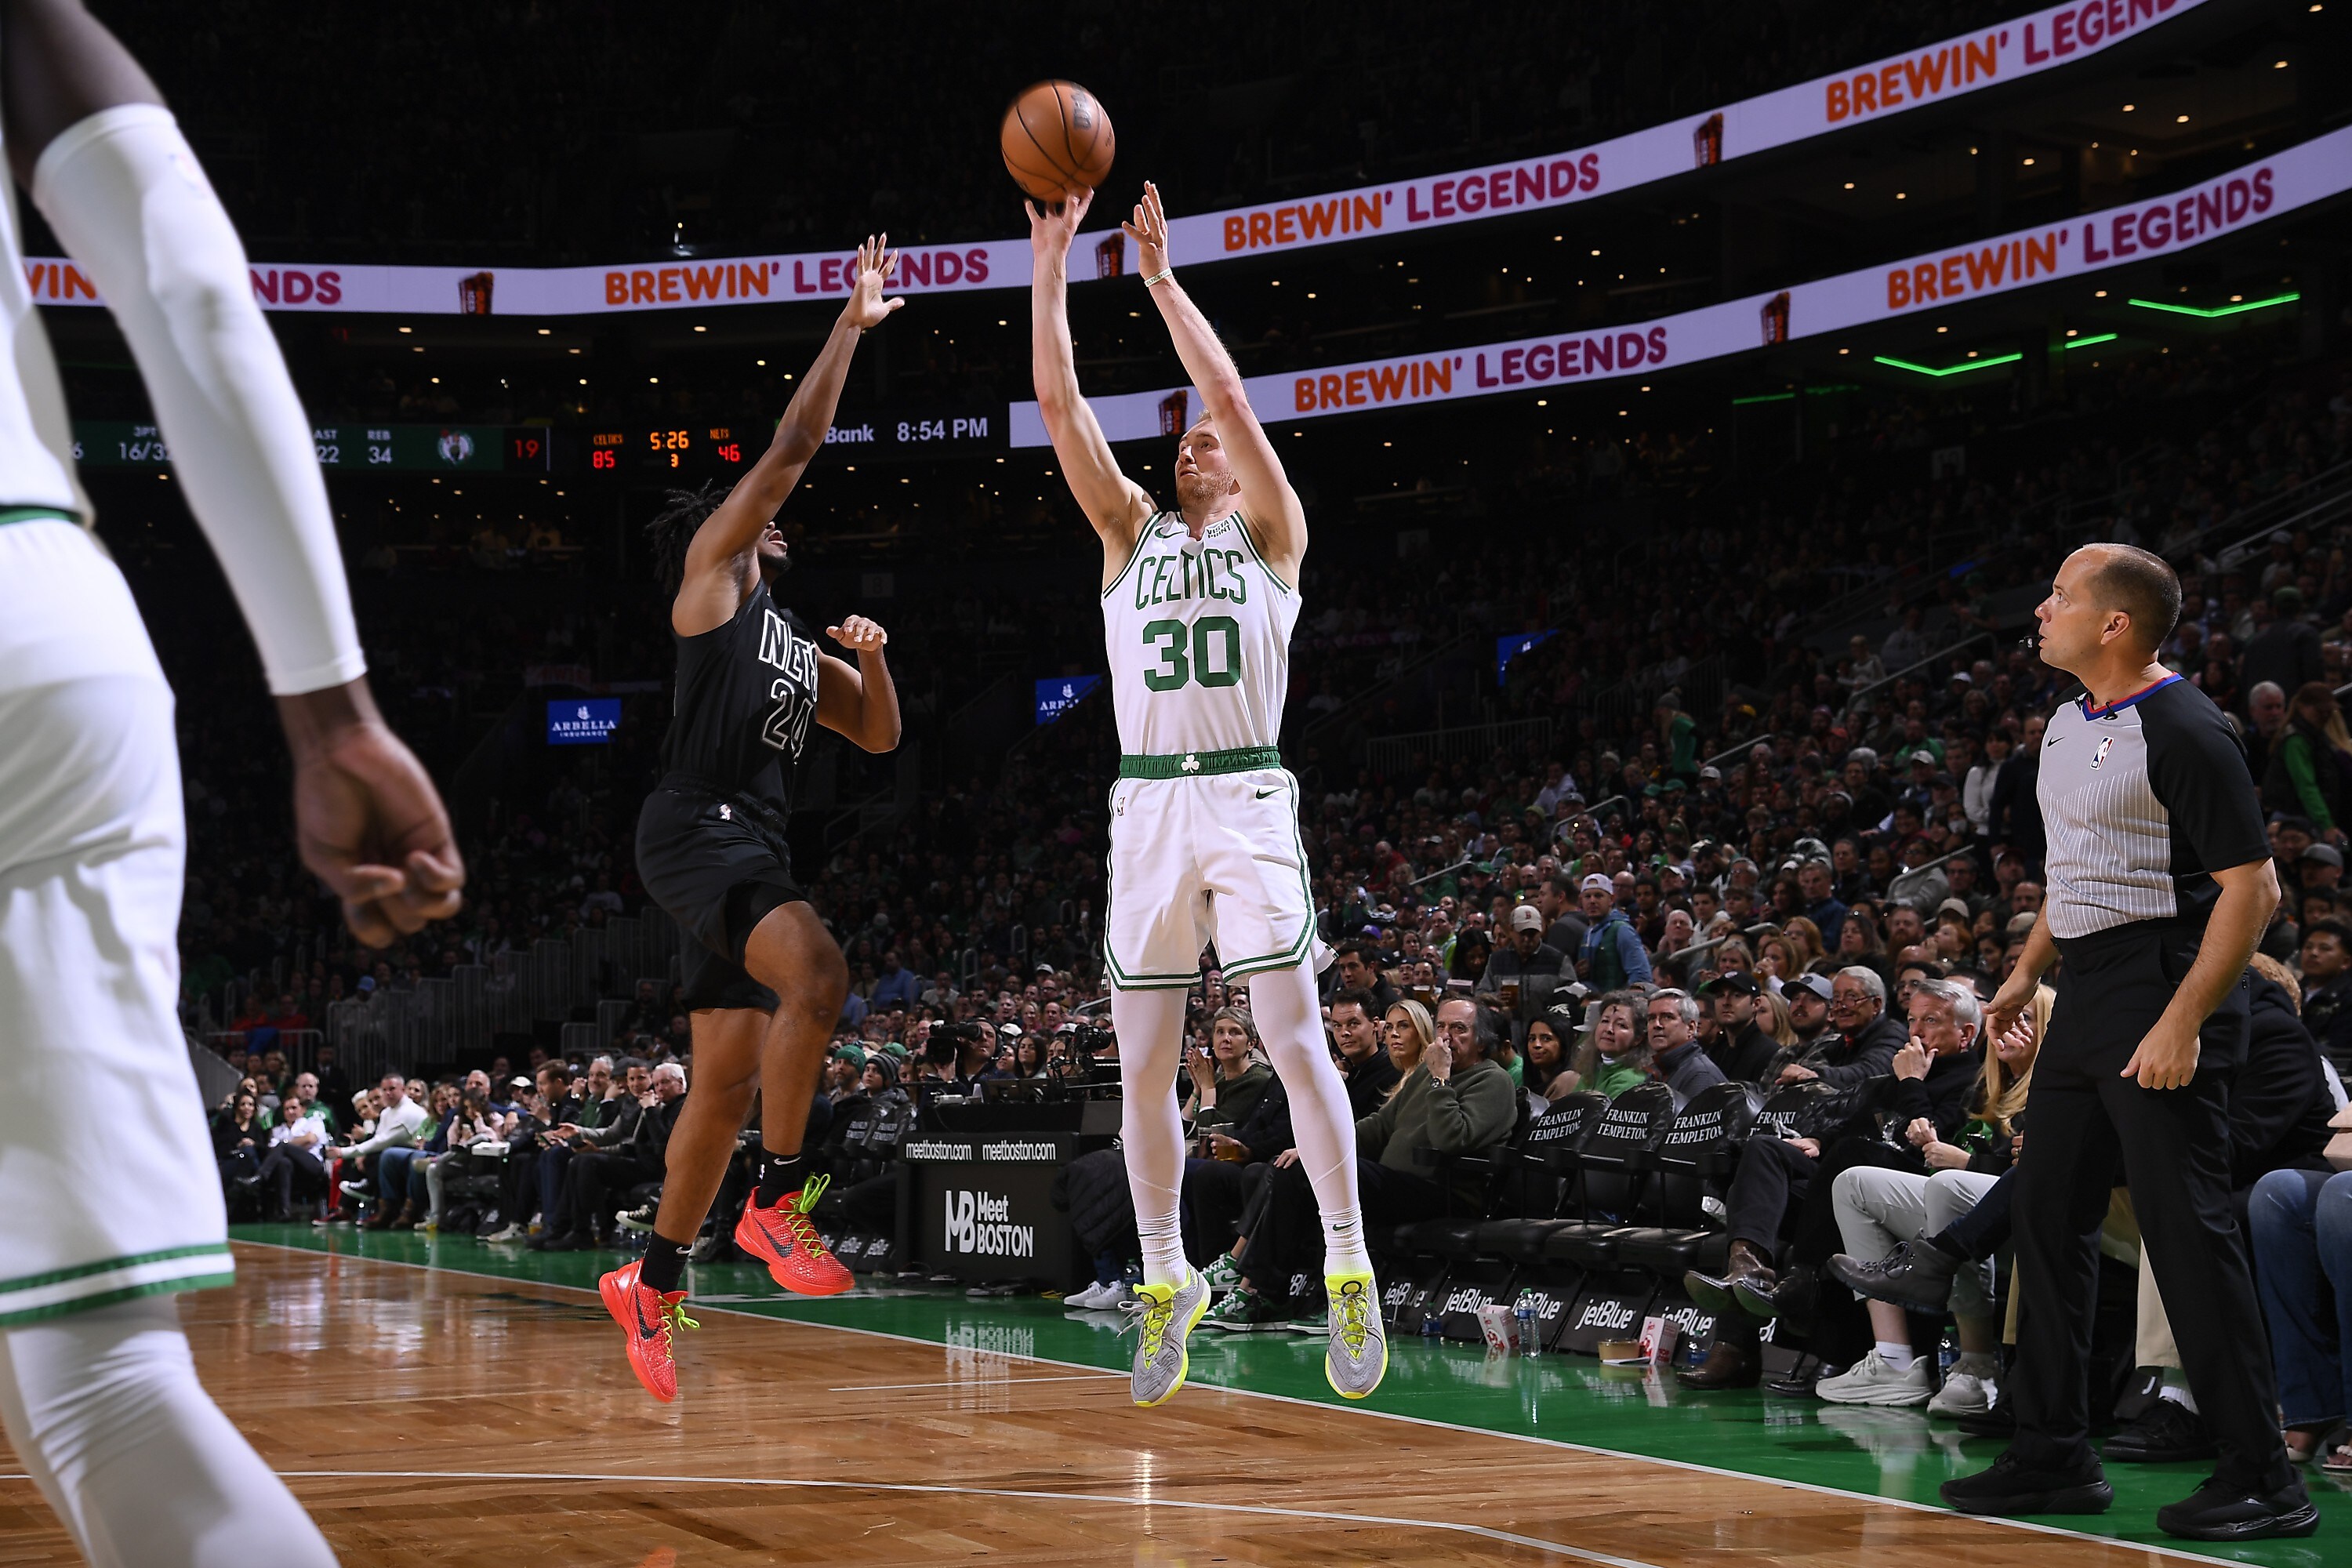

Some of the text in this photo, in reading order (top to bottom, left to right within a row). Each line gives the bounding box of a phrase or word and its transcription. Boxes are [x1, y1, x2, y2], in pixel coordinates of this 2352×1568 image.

[1825, 0, 2178, 123] BREWIN' LEGEN
[1223, 152, 1600, 252] BREWIN' LEGENDS
[1887, 167, 2273, 310] BREWIN' LEGENDS
[604, 262, 780, 307] BREWIN'
[1294, 326, 1668, 413] BREWIN' LEGENDS
[650, 430, 690, 451] 5:26
[825, 424, 874, 444] Bank
[897, 417, 988, 442] 8:54 PM
[317, 445, 339, 463] 22
[368, 445, 392, 464] 34
[515, 440, 539, 458] 19
[592, 450, 615, 469] 85
[718, 444, 741, 463] 46
[670, 453, 680, 468] 3
[1207, 520, 1229, 534] VISTA
[1208, 524, 1231, 539] PRINT
[1135, 548, 1247, 611] CELTICS
[1142, 616, 1242, 692] 30
[760, 677, 815, 760] 24
[1537, 1108, 1584, 1127] FRANKLIN
[1606, 1109, 1650, 1124] FRANKLIN
[1673, 1109, 1723, 1130] FRANKLIN
[906, 1139, 1056, 1161] meetboston.com meetboston.com
[977, 1191, 1009, 1222] Meet
[945, 1190, 976, 1254] MB
[977, 1223, 1033, 1258] BOSTON
[1574, 1298, 1634, 1330] jetBlue
